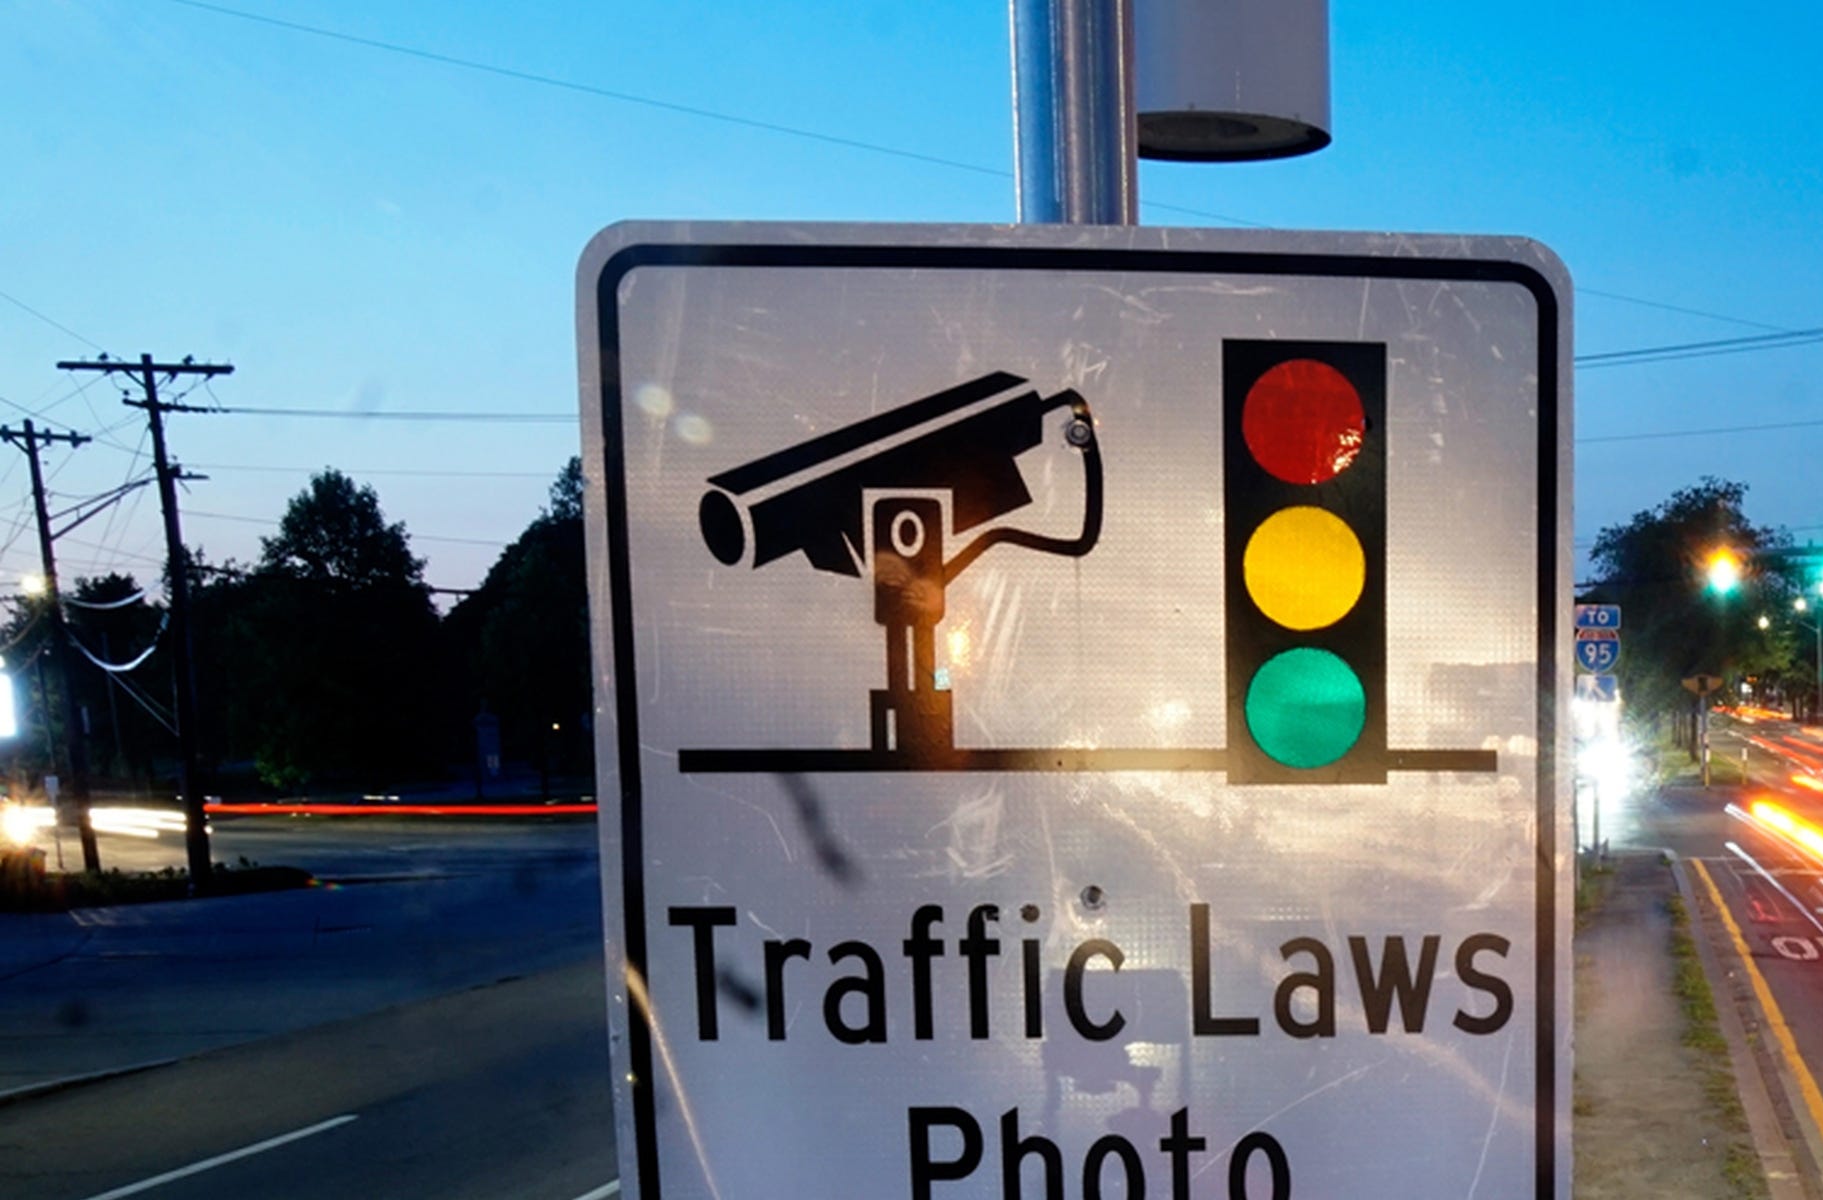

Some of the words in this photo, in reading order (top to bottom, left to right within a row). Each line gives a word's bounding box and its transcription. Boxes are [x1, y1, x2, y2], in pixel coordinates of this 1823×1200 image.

[1586, 611, 1609, 624] TO
[1585, 643, 1612, 664] 95
[668, 903, 1127, 1045] Traffic
[1189, 902, 1514, 1039] Laws
